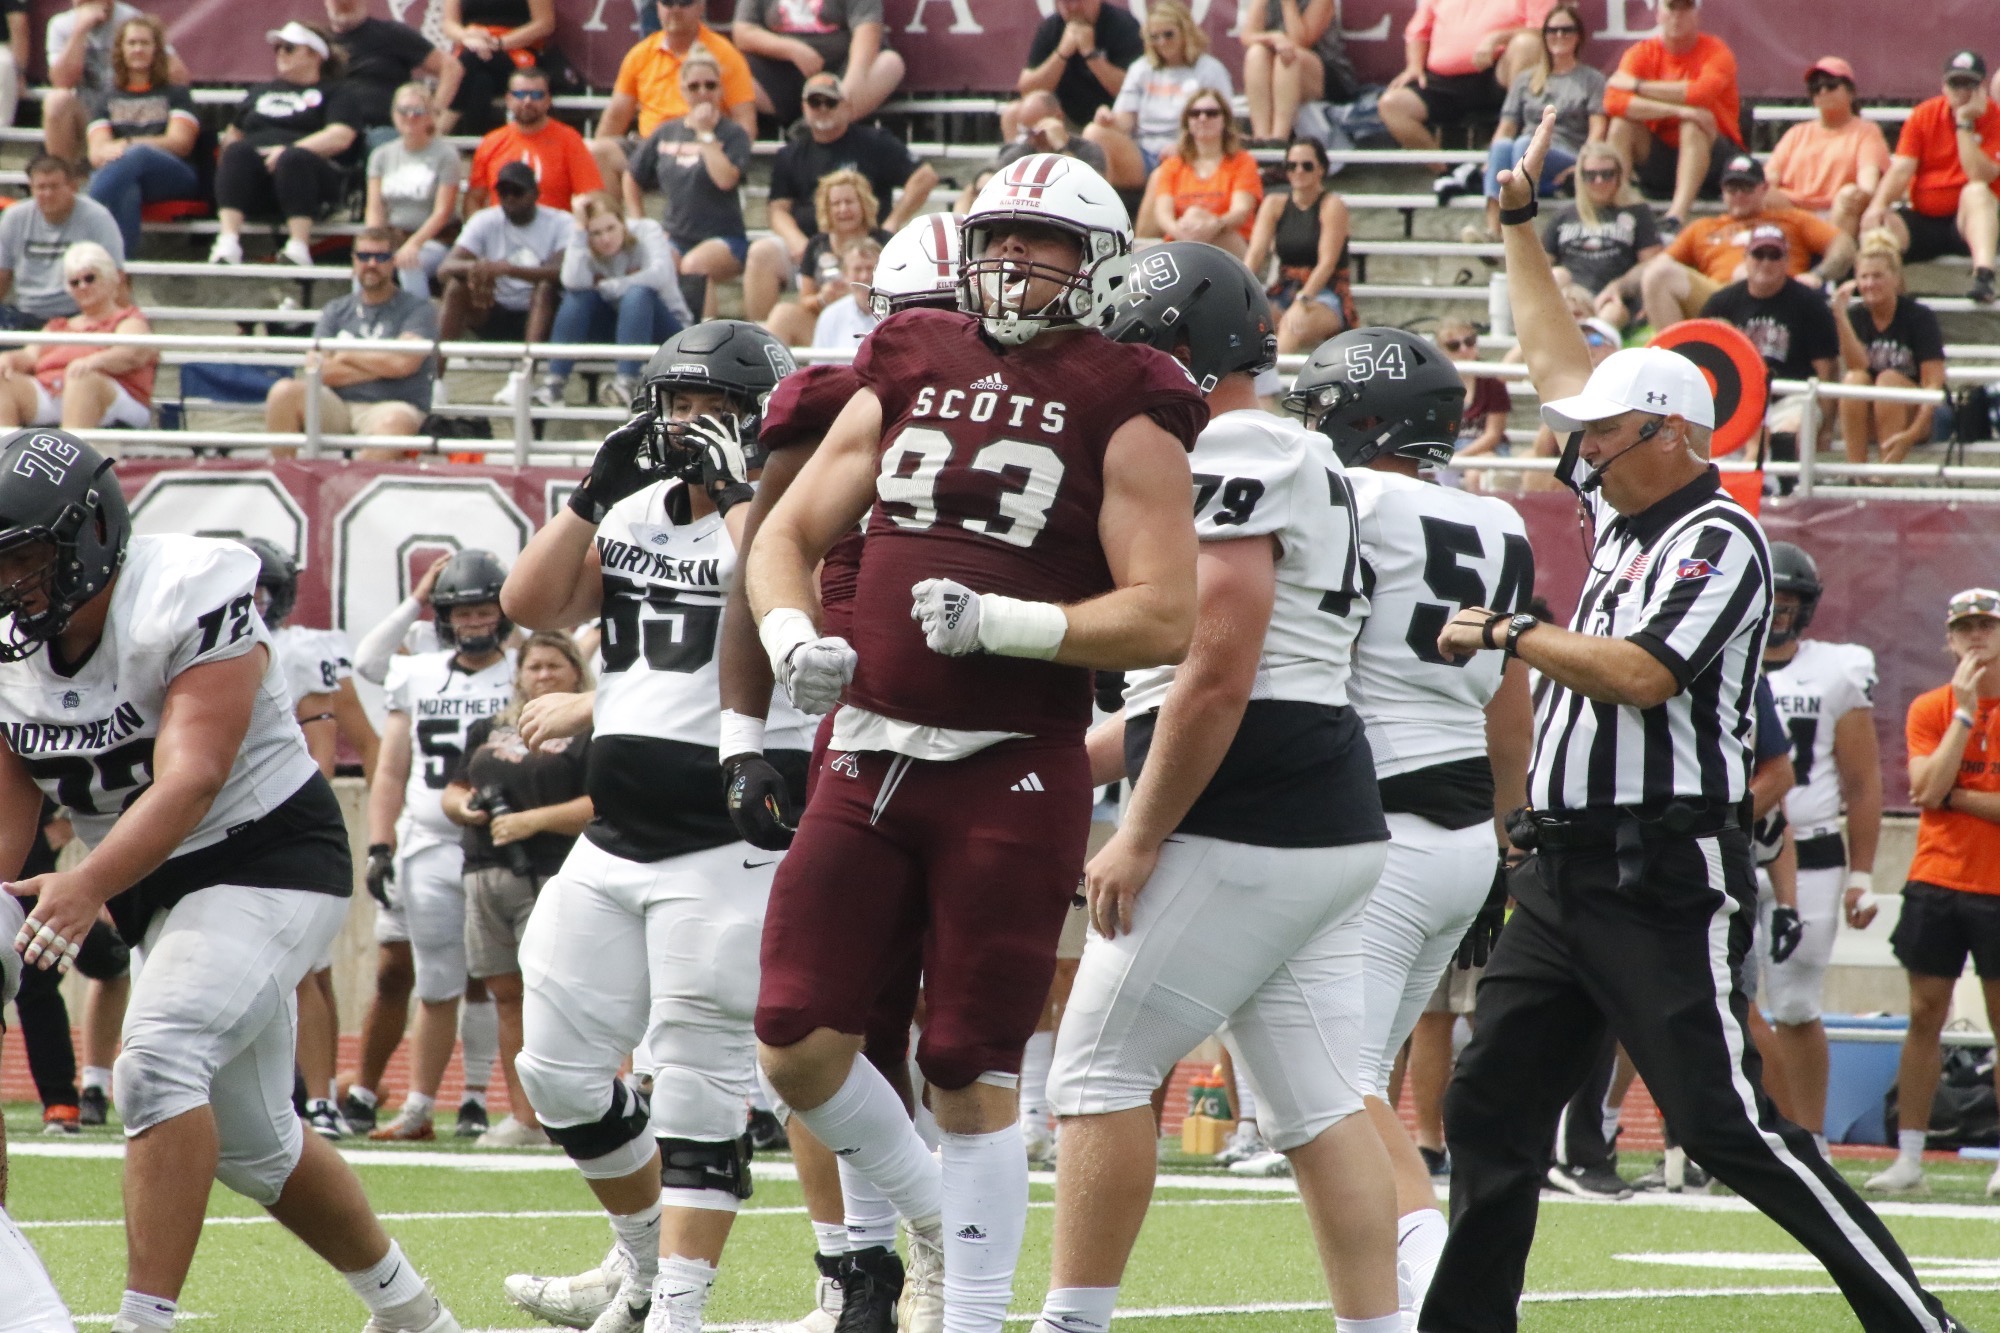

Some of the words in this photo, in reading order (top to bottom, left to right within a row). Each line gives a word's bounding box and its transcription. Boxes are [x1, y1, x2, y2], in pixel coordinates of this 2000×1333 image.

[1000, 199, 1040, 208] KILTSTYLE
[970, 381, 1008, 391] adidas
[1345, 344, 1406, 383] 54
[912, 387, 1067, 434] SCOTS
[13, 434, 80, 485] 72
[876, 427, 1066, 548] 93
[1193, 473, 1265, 526] 79
[597, 536, 719, 585] NORTHERN
[601, 574, 722, 674] 65
[947, 592, 970, 630] adidas
[831, 753, 860, 778] A
